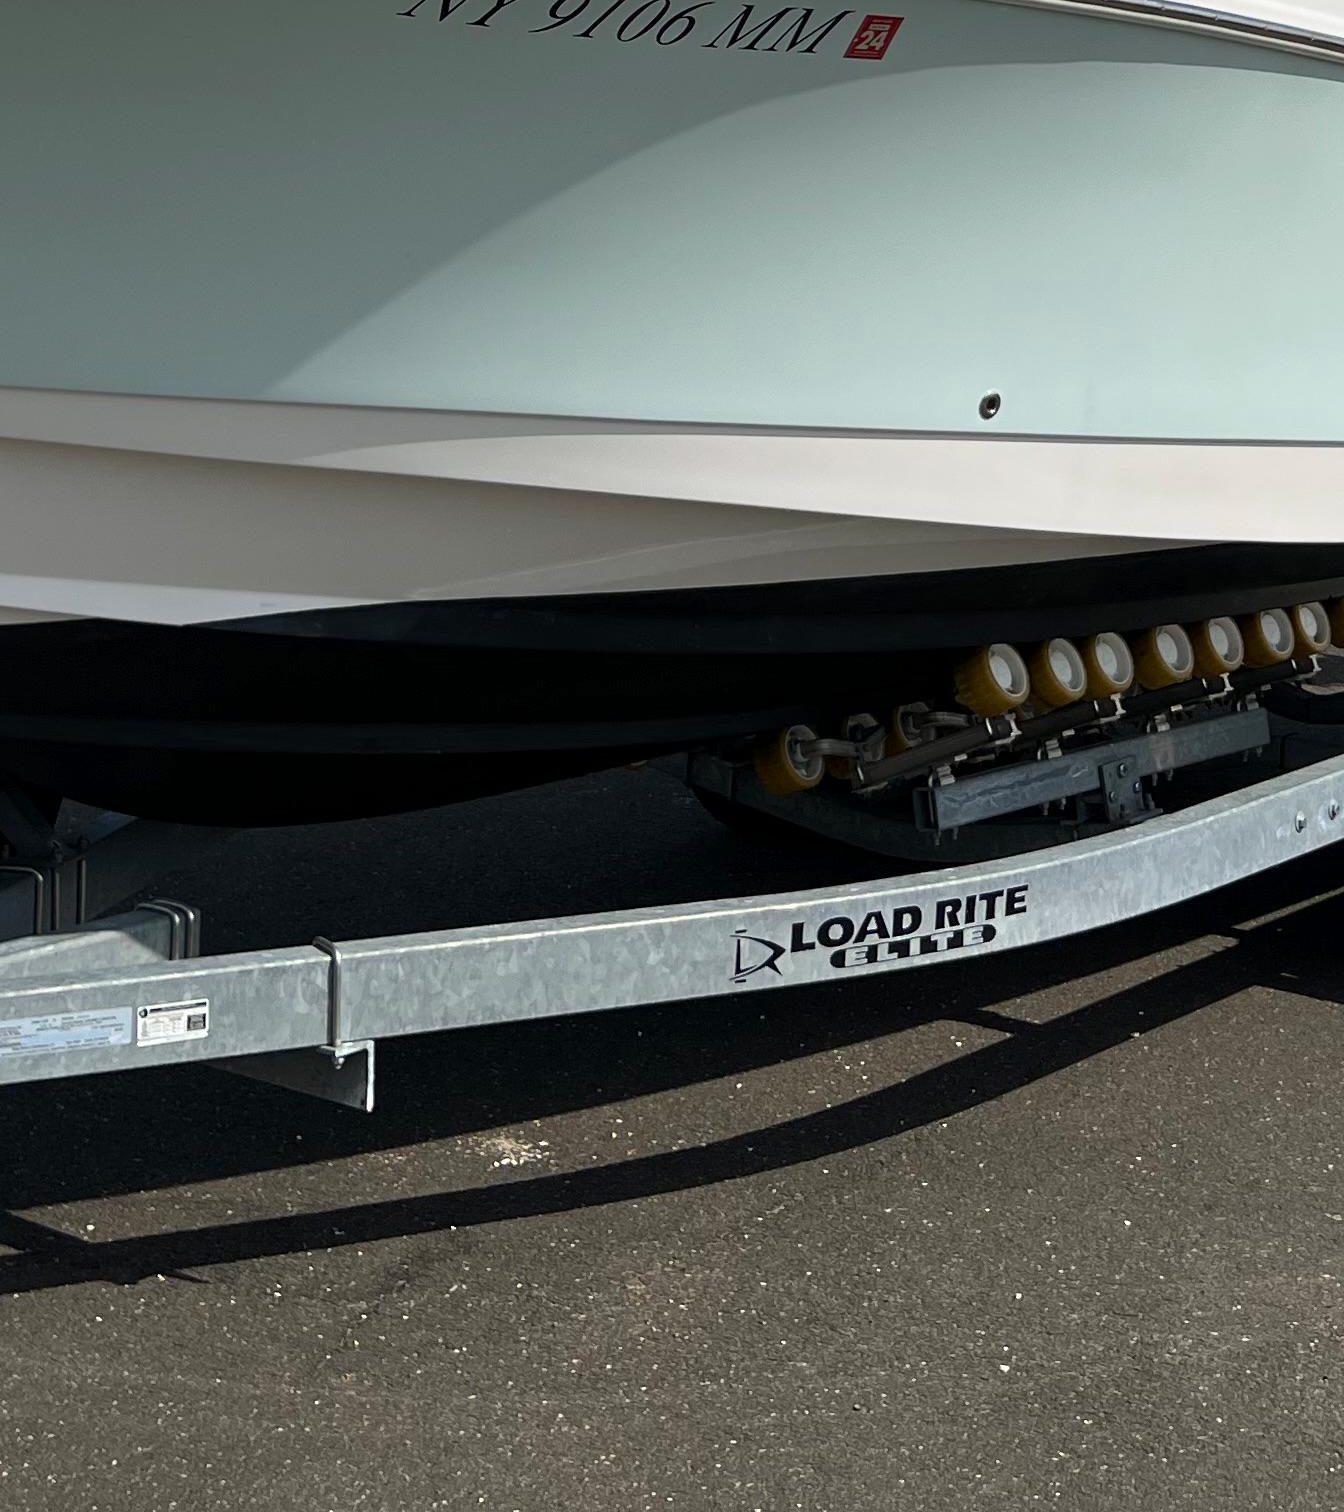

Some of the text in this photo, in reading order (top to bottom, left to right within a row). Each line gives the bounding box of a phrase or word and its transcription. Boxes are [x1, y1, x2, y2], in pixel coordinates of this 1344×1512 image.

[701, 4, 857, 55] MM
[854, 30, 889, 51] 24
[790, 884, 1029, 953] LOAD RITE
[844, 925, 985, 967] ELITE
